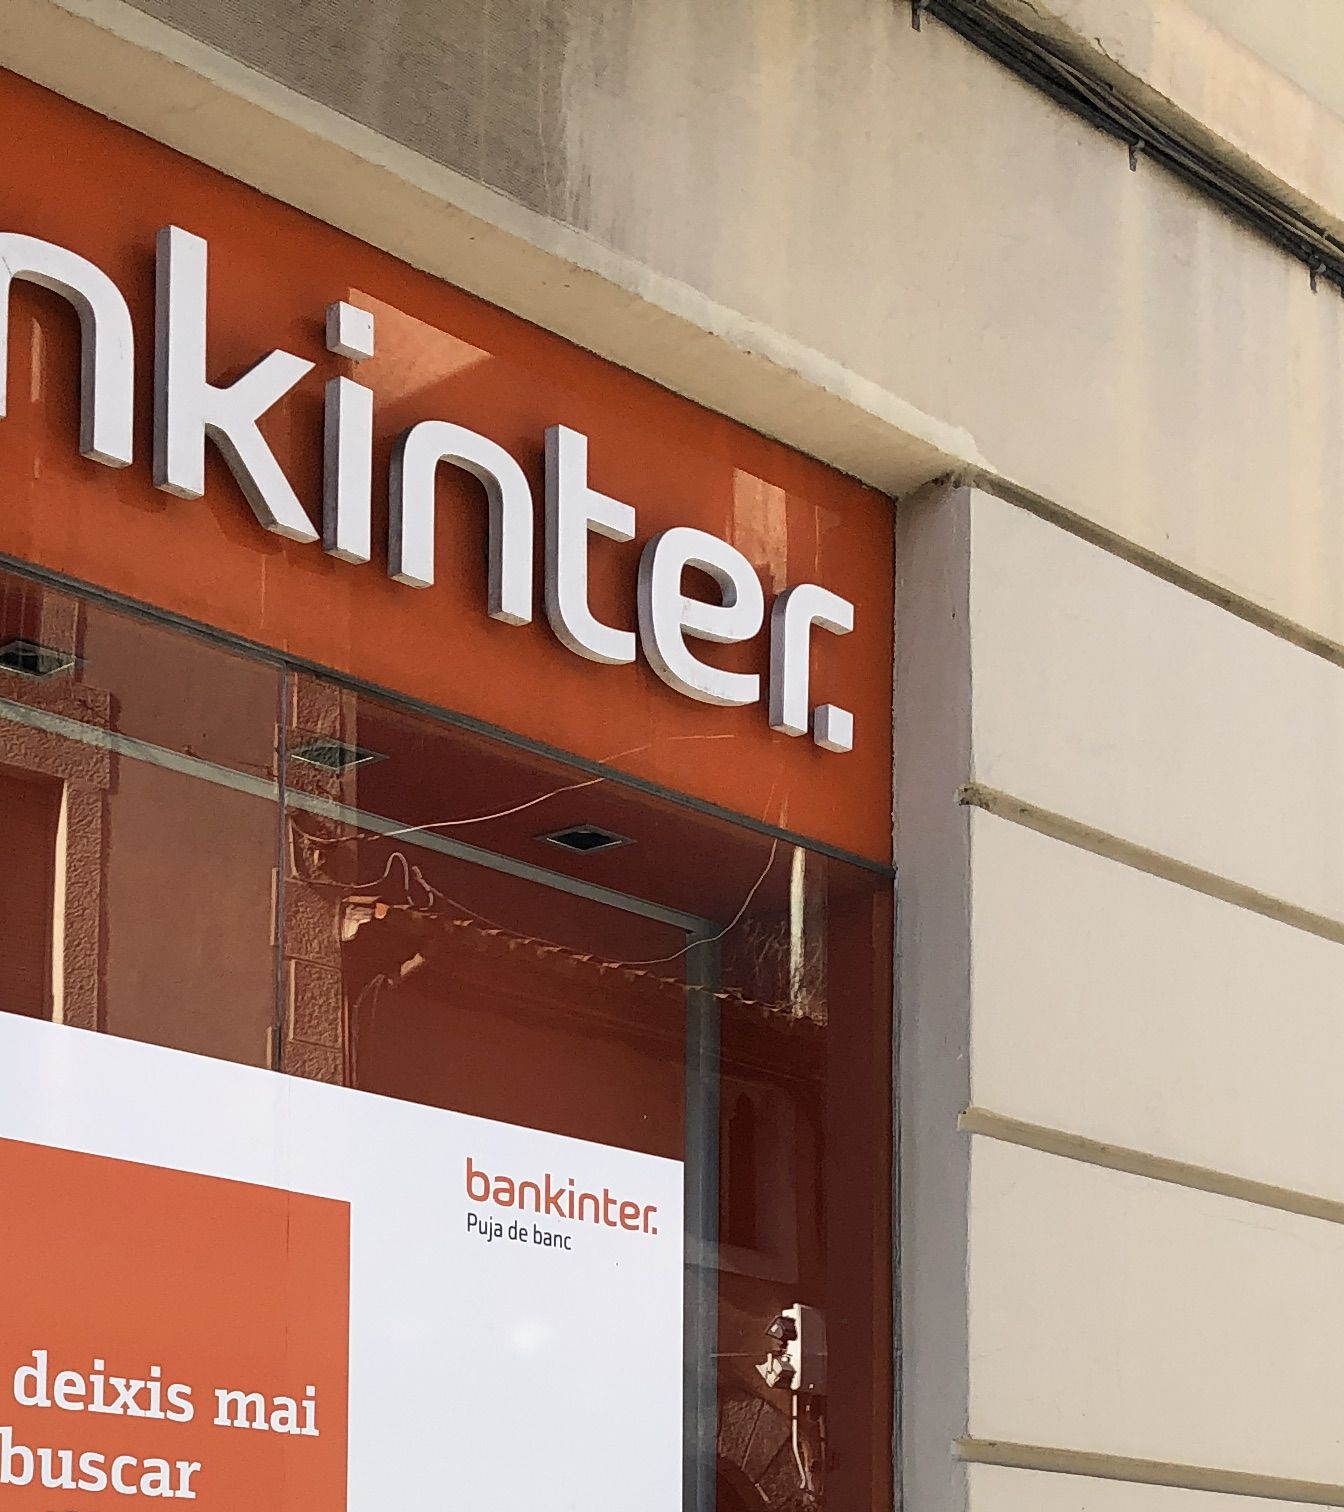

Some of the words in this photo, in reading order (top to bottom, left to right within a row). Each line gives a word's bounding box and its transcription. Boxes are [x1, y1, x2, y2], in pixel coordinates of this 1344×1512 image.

[466, 1157, 657, 1235] bankinter.
[467, 1213, 503, 1242] Puja
[508, 1220, 528, 1242] de
[532, 1224, 571, 1250] banc
[13, 1349, 195, 1422] deixis
[213, 1385, 320, 1437] mai
